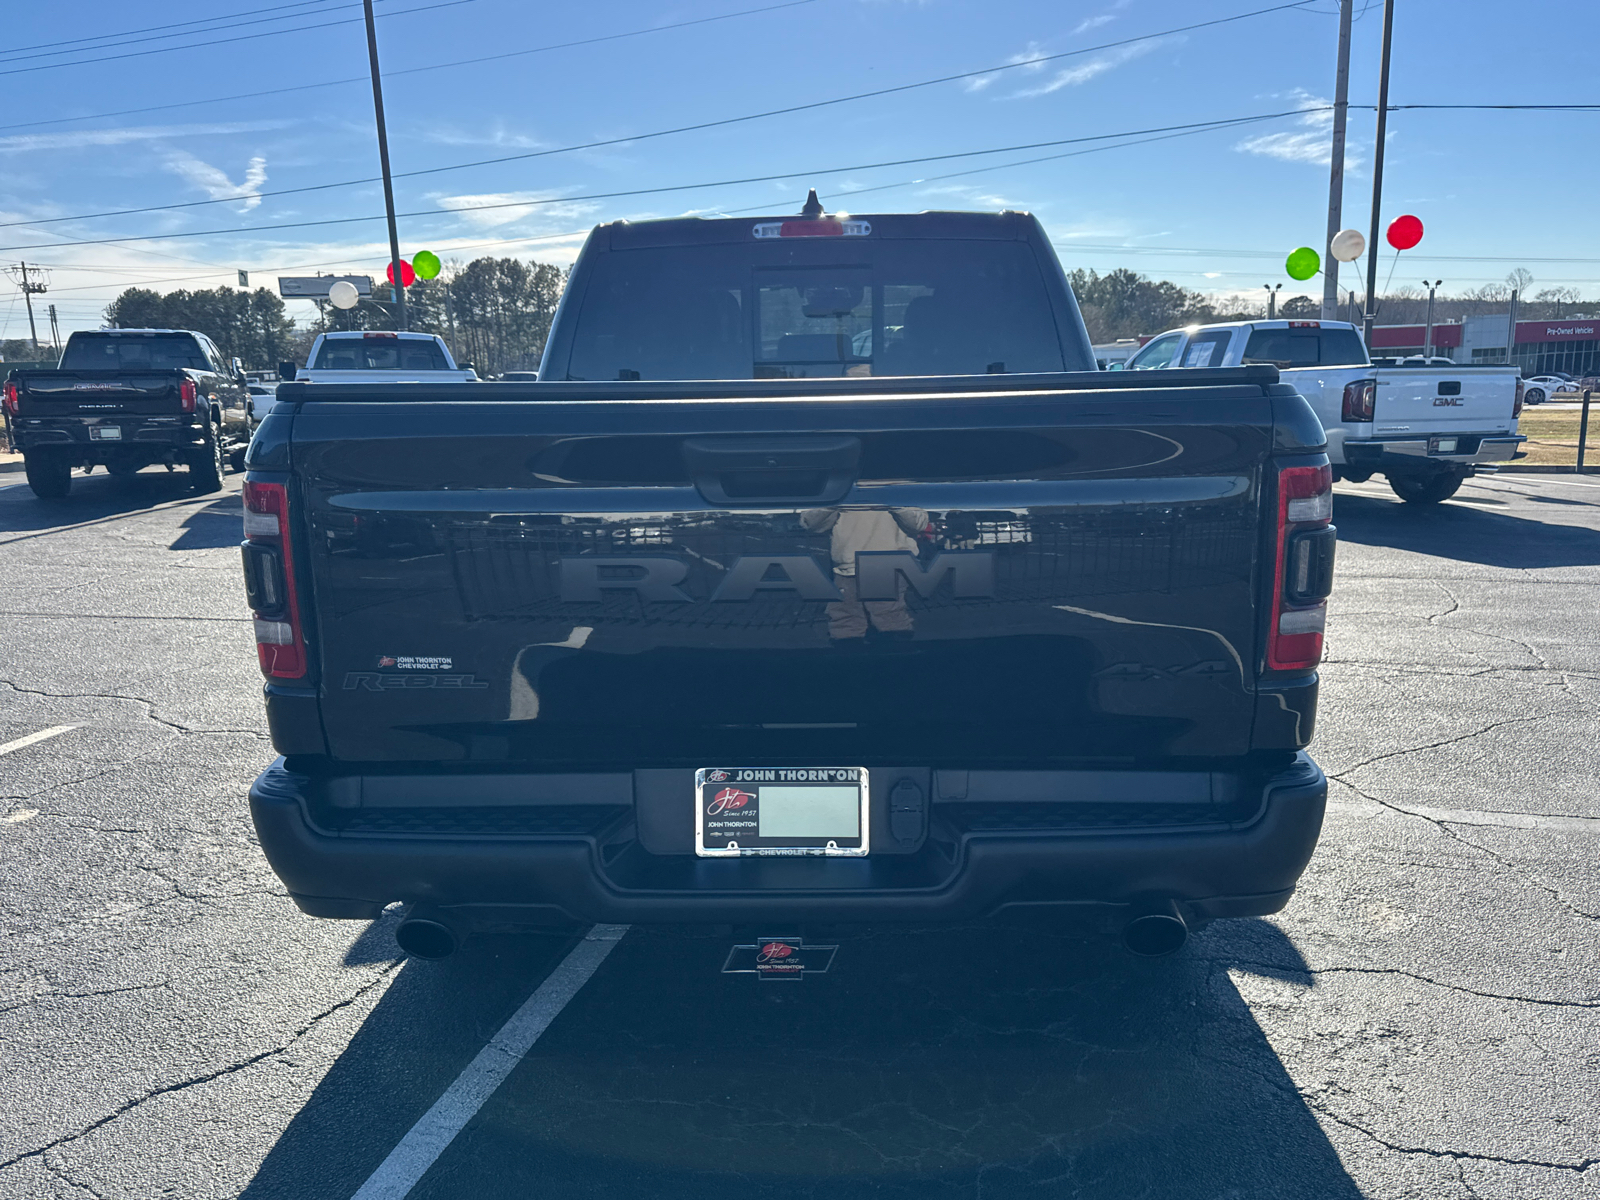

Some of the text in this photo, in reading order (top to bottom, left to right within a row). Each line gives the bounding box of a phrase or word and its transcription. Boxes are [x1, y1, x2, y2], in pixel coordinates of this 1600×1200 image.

[1546, 326, 1594, 336] Pre-Owned Vehicles
[1432, 397, 1465, 407] GMC
[559, 551, 997, 601] RAM
[342, 671, 490, 692] REBEL
[736, 769, 775, 781] JOHN
